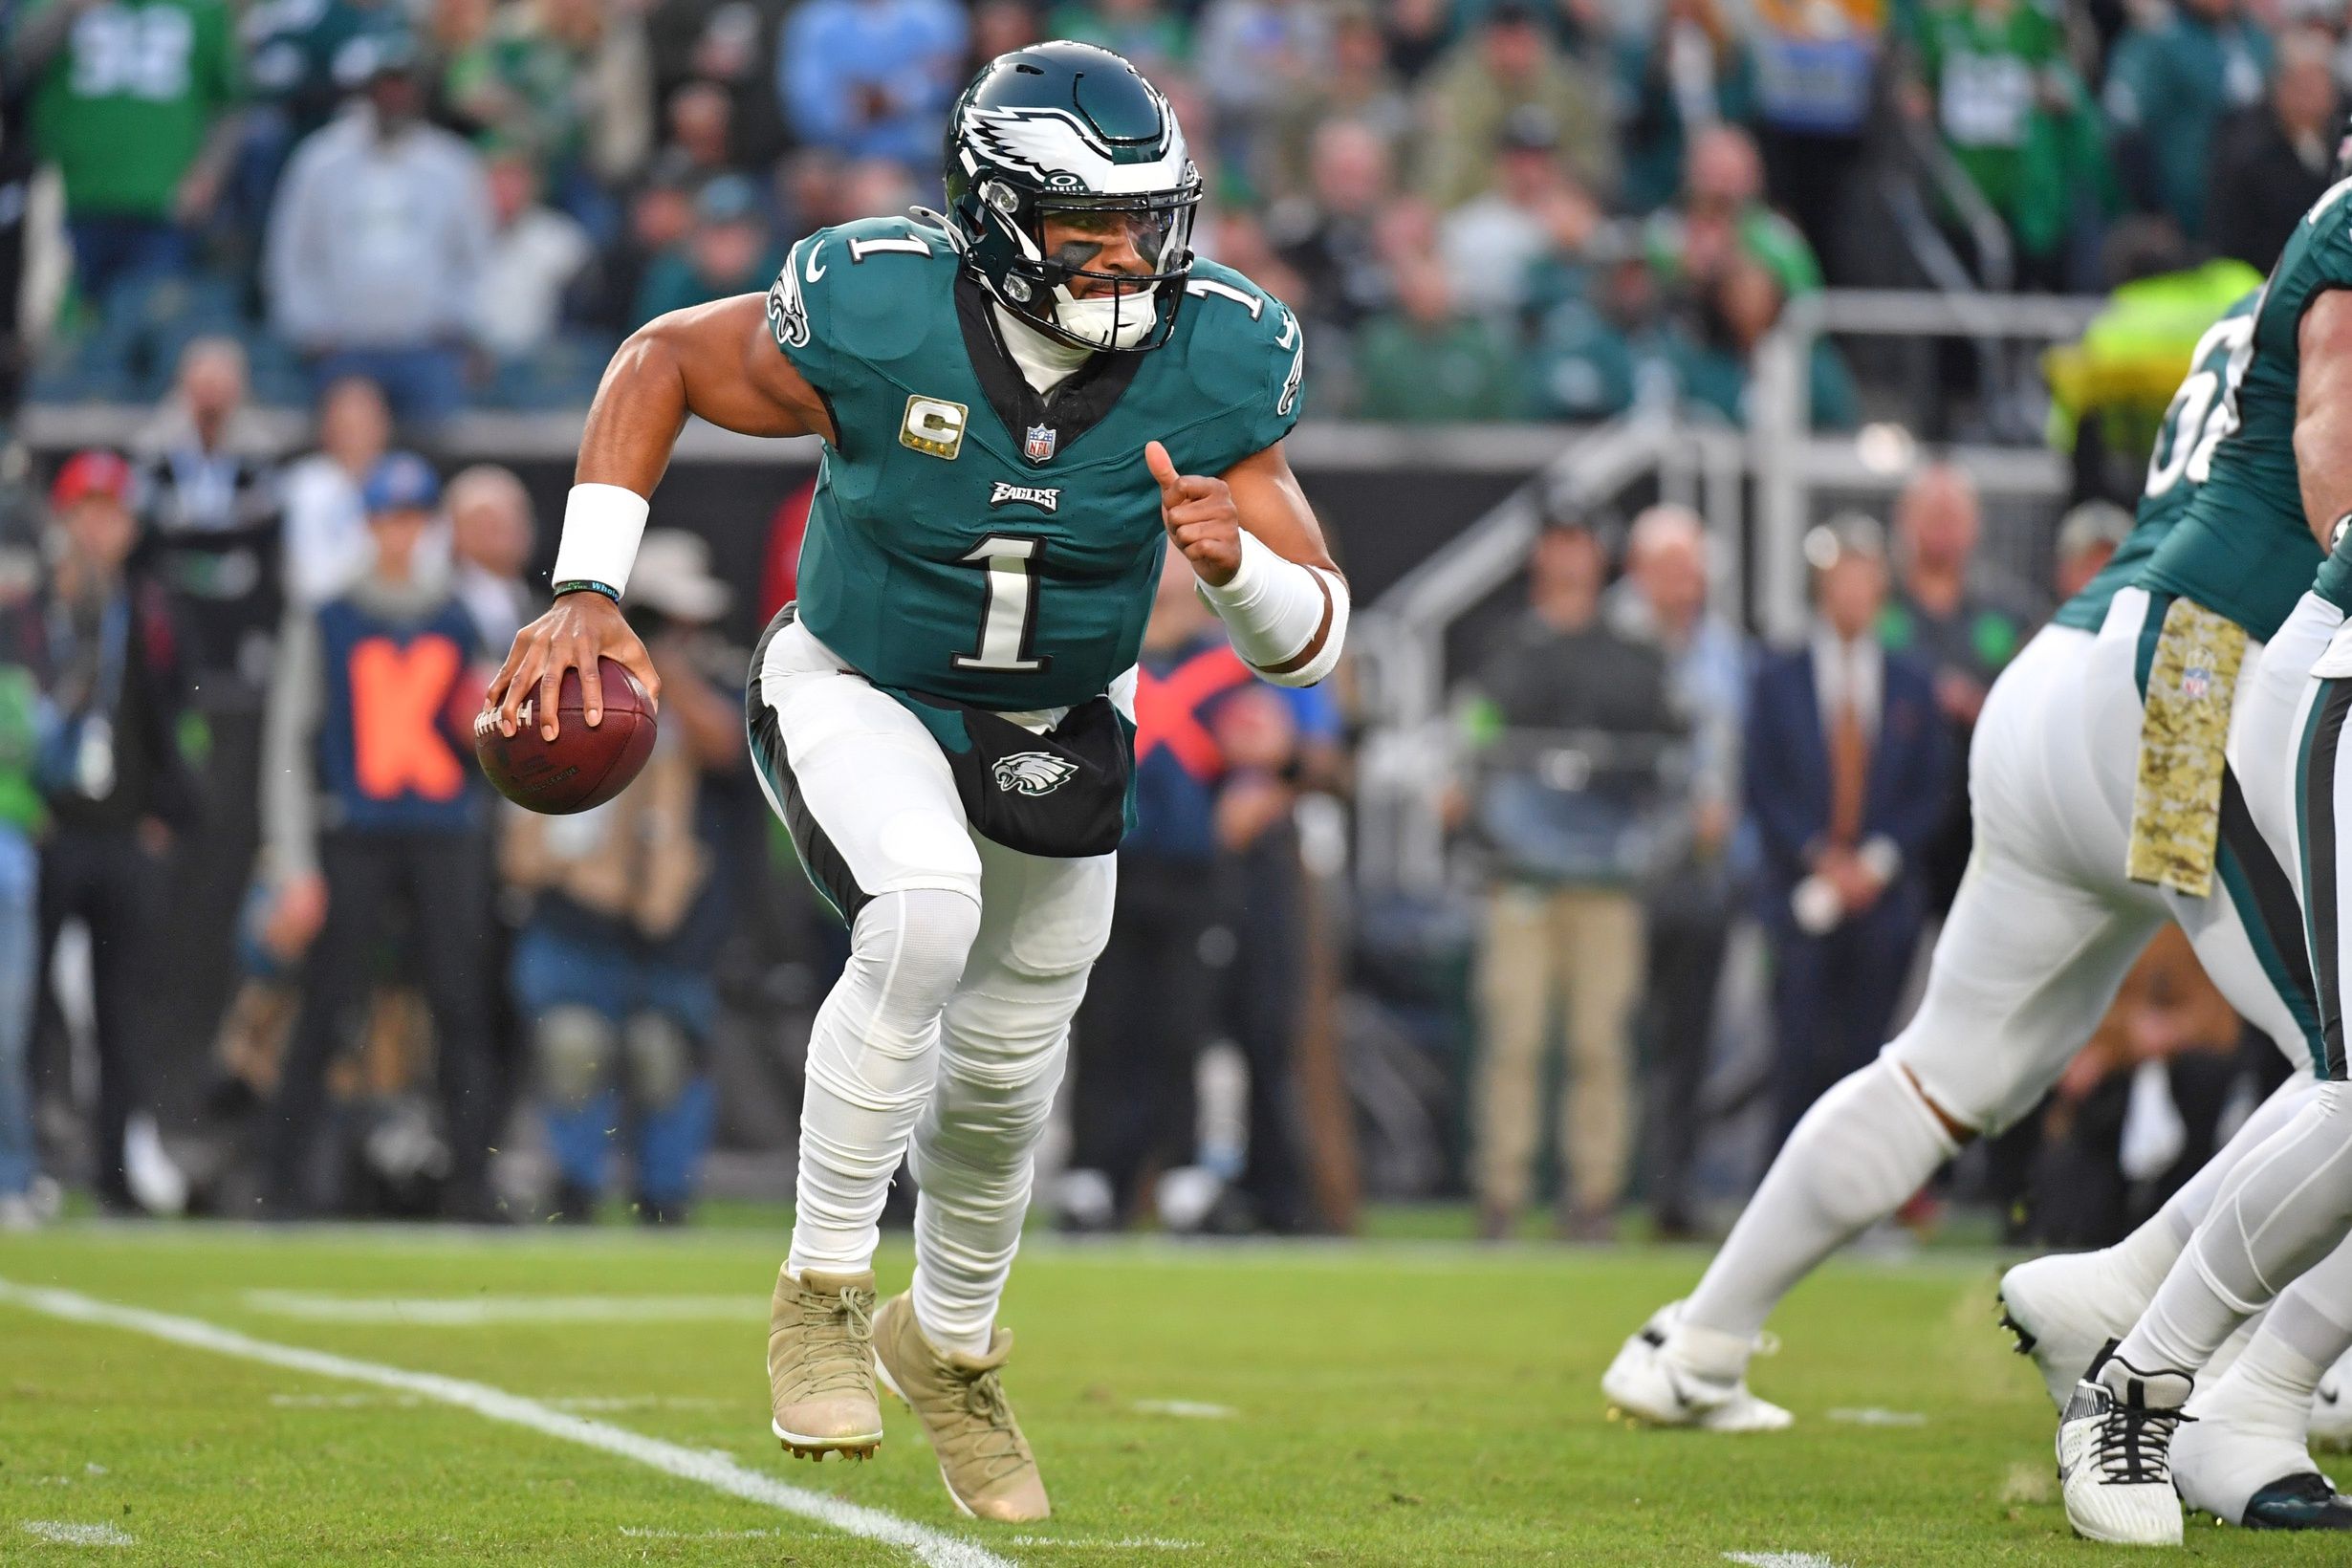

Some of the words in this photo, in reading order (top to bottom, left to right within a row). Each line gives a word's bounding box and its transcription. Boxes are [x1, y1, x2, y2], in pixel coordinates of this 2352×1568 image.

[848, 232, 933, 264] 1
[1186, 277, 1263, 321] 1
[908, 402, 962, 444] C
[1028, 441, 1050, 457] NFL
[990, 482, 1061, 512] EAGLES
[952, 533, 1049, 671] 1
[347, 633, 466, 801] K
